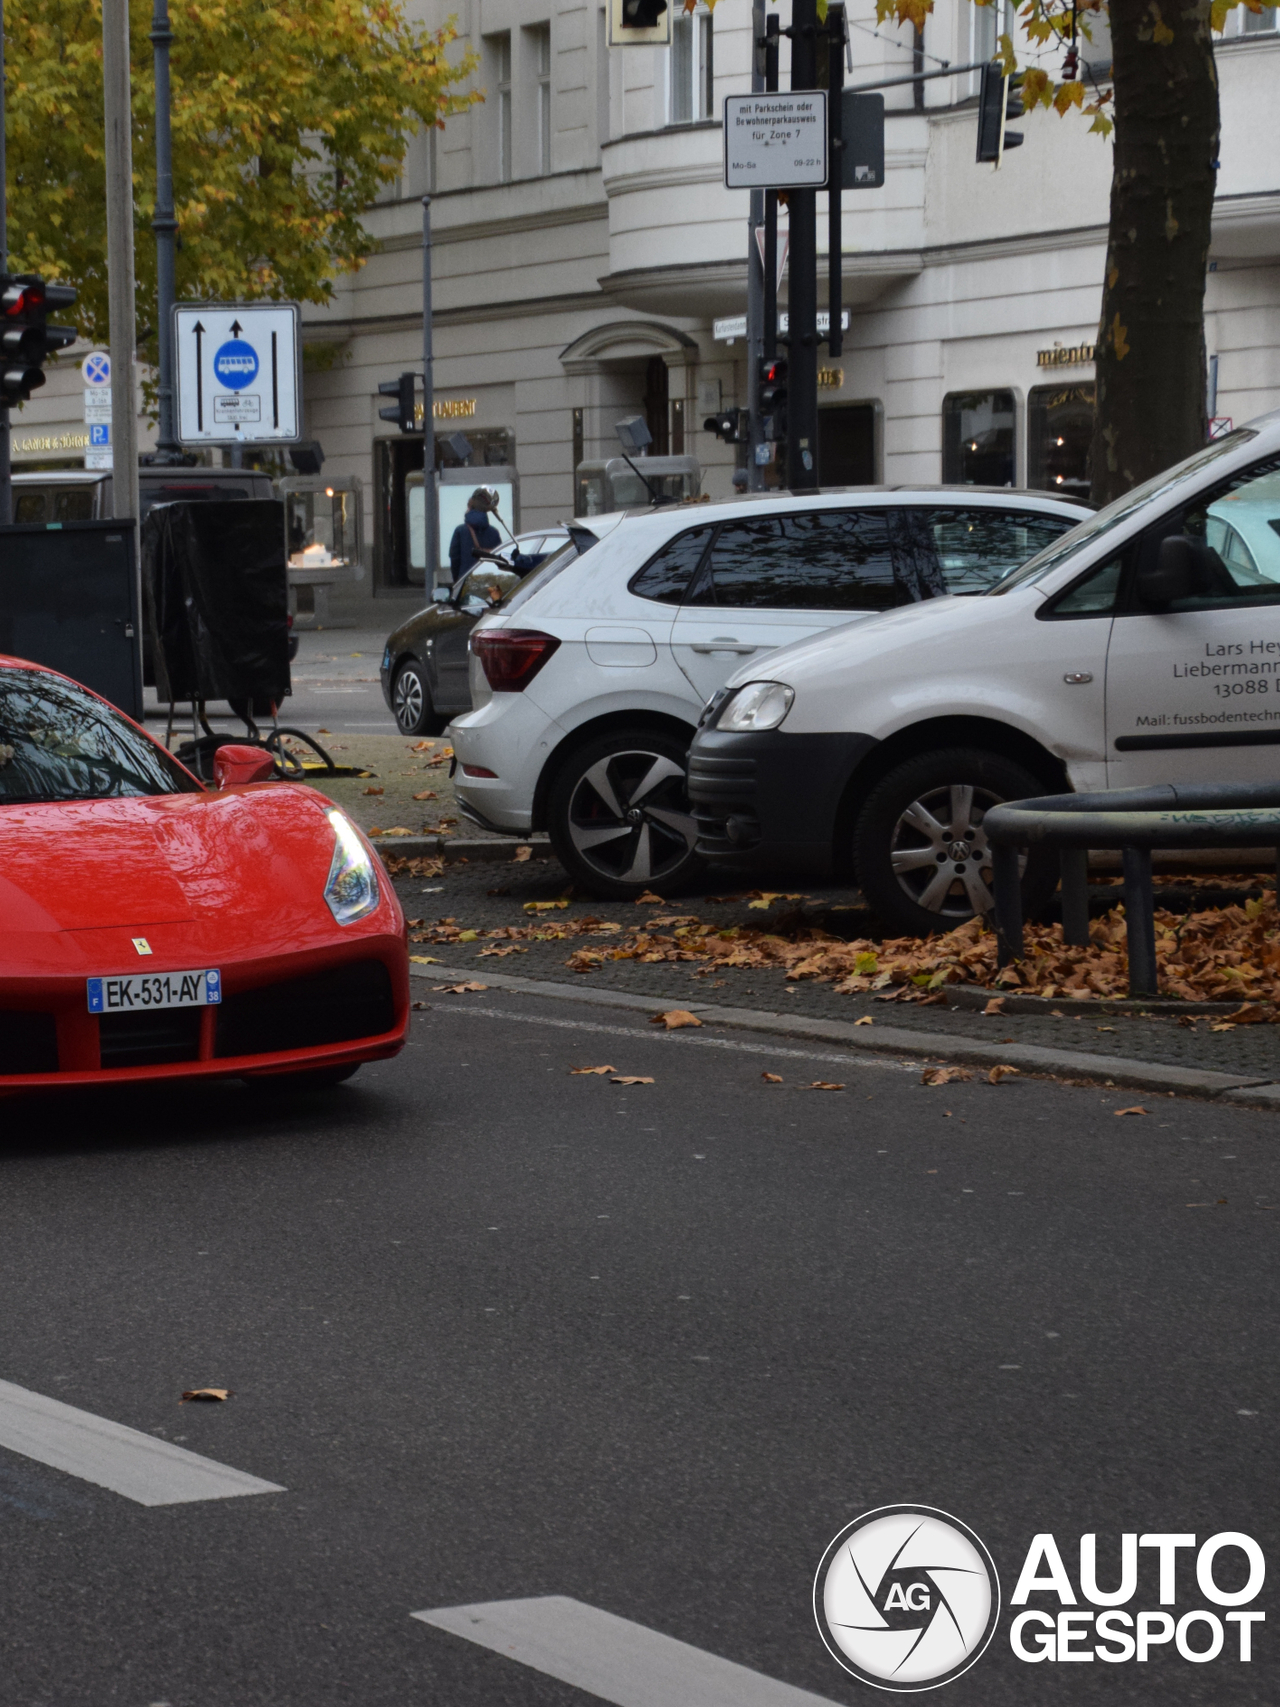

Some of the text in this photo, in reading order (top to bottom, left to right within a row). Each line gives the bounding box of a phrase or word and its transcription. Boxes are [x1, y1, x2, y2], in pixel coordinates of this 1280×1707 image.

[739, 102, 813, 114] mit Parkschein oder
[752, 129, 801, 140] für Zone 7
[732, 162, 757, 170] Mo-Sa
[794, 159, 814, 167] 09-22
[1036, 341, 1097, 367] mientu
[438, 398, 477, 418] LAURENT
[1205, 642, 1243, 657] Lars
[1213, 679, 1269, 698] 13088
[1136, 714, 1171, 727] Mail:
[92, 974, 219, 1008] F EK-531-AY 38
